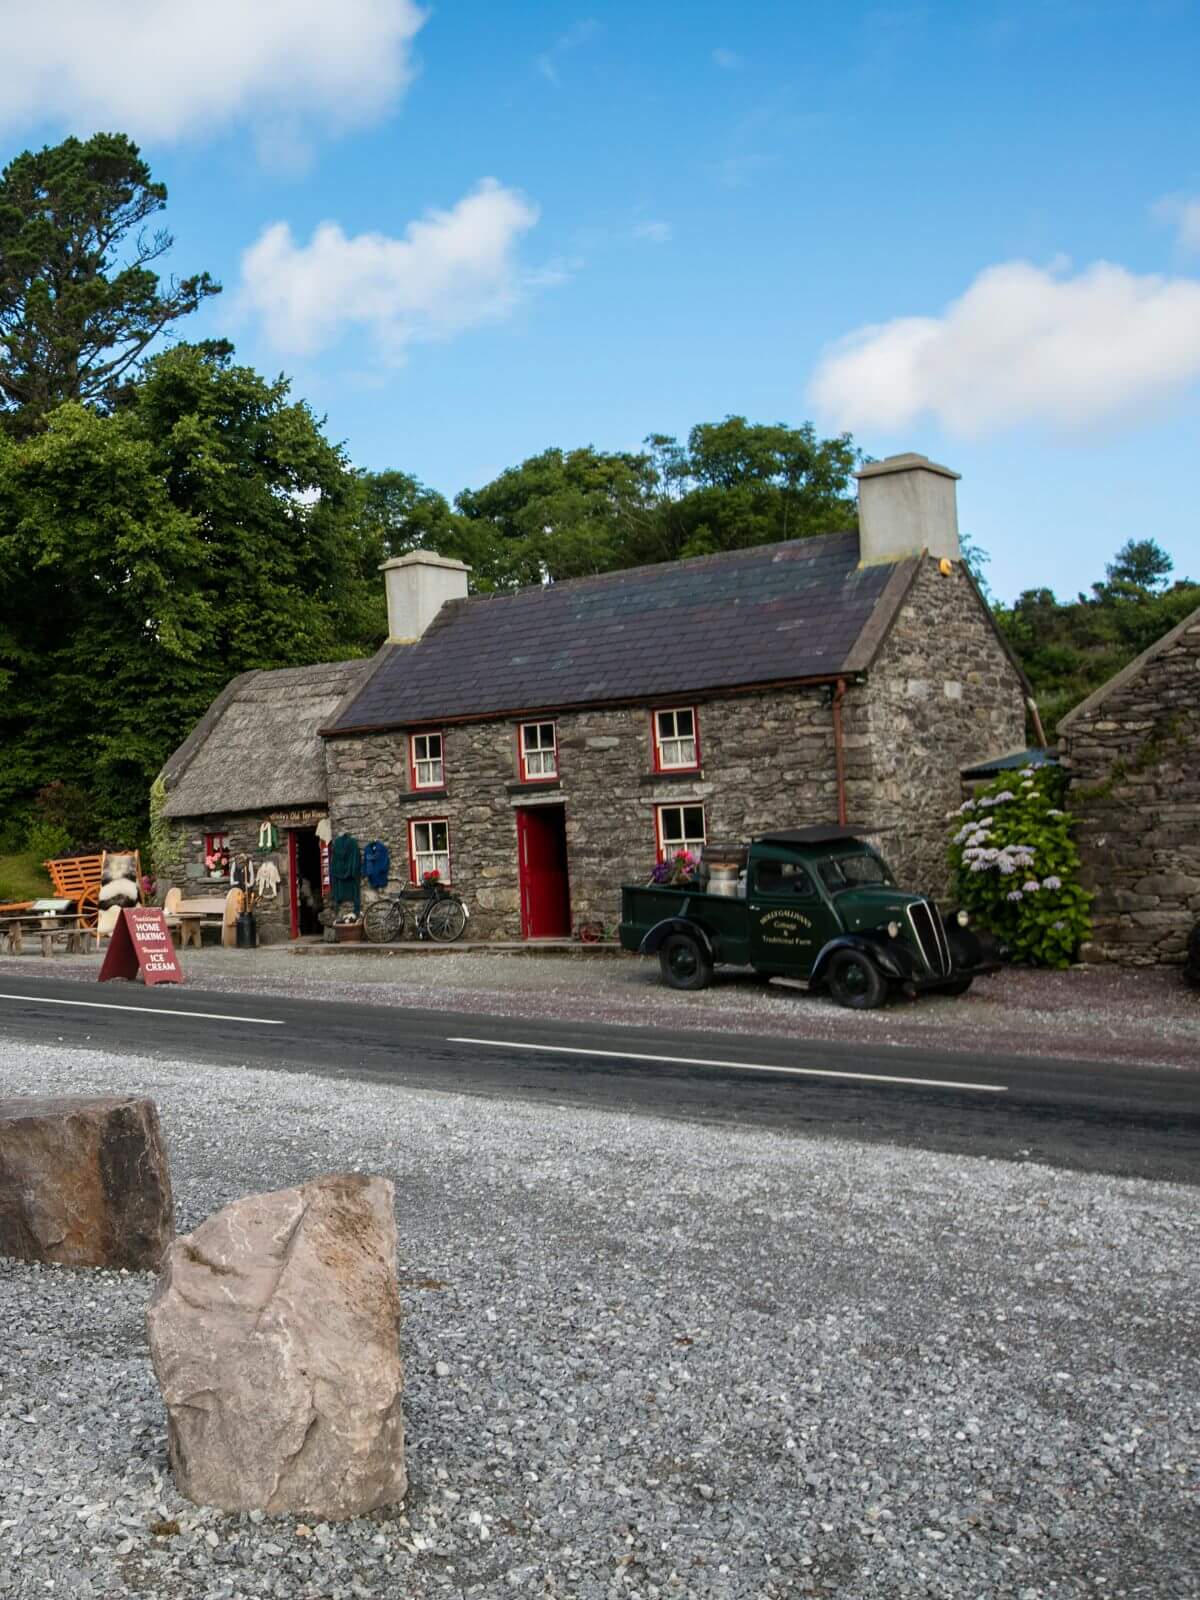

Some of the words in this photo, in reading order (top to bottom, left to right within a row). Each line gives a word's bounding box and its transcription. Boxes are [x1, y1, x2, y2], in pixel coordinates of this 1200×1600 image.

[136, 923, 160, 931] HOME
[136, 932, 166, 941] BAKING
[150, 954, 164, 962] ICE
[145, 963, 176, 971] CREAM
